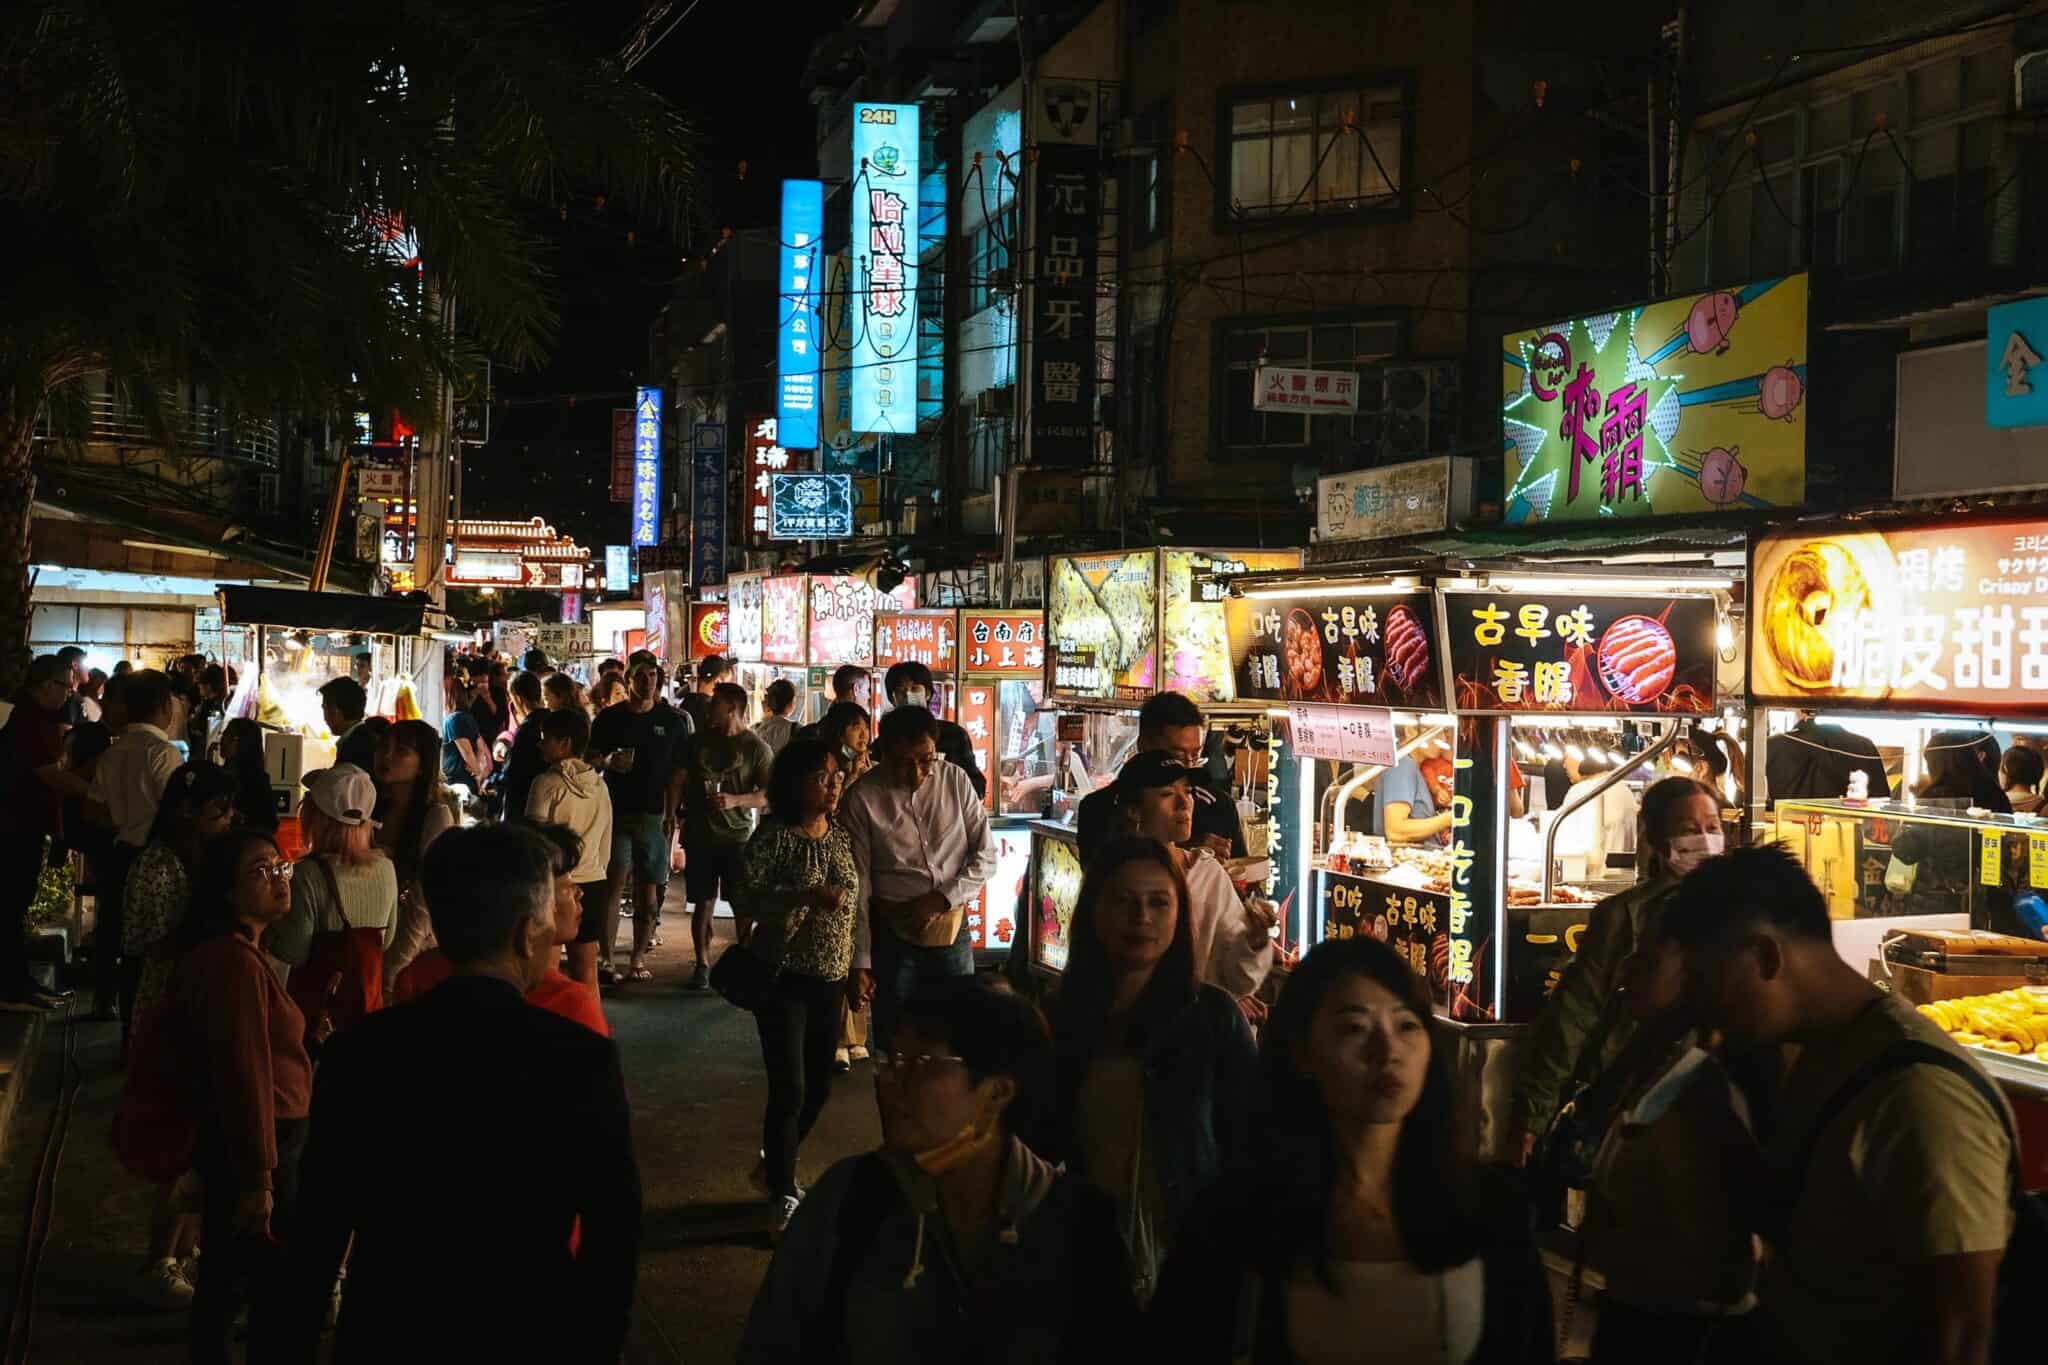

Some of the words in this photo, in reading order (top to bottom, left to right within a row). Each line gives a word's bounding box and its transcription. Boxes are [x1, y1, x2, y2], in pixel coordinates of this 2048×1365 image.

[860, 108, 896, 124] 24H
[871, 190, 906, 316] 哈啦星球
[1042, 173, 1088, 403] 元品牙醫
[1897, 545, 1966, 592] 現烤
[1979, 576, 2032, 595] Crispy
[1321, 604, 1380, 644] 古早味
[1472, 603, 1595, 648] 古早味
[1337, 655, 1375, 694] 香腸
[1491, 659, 1575, 704] 香腸
[1385, 891, 1438, 936] 古早味
